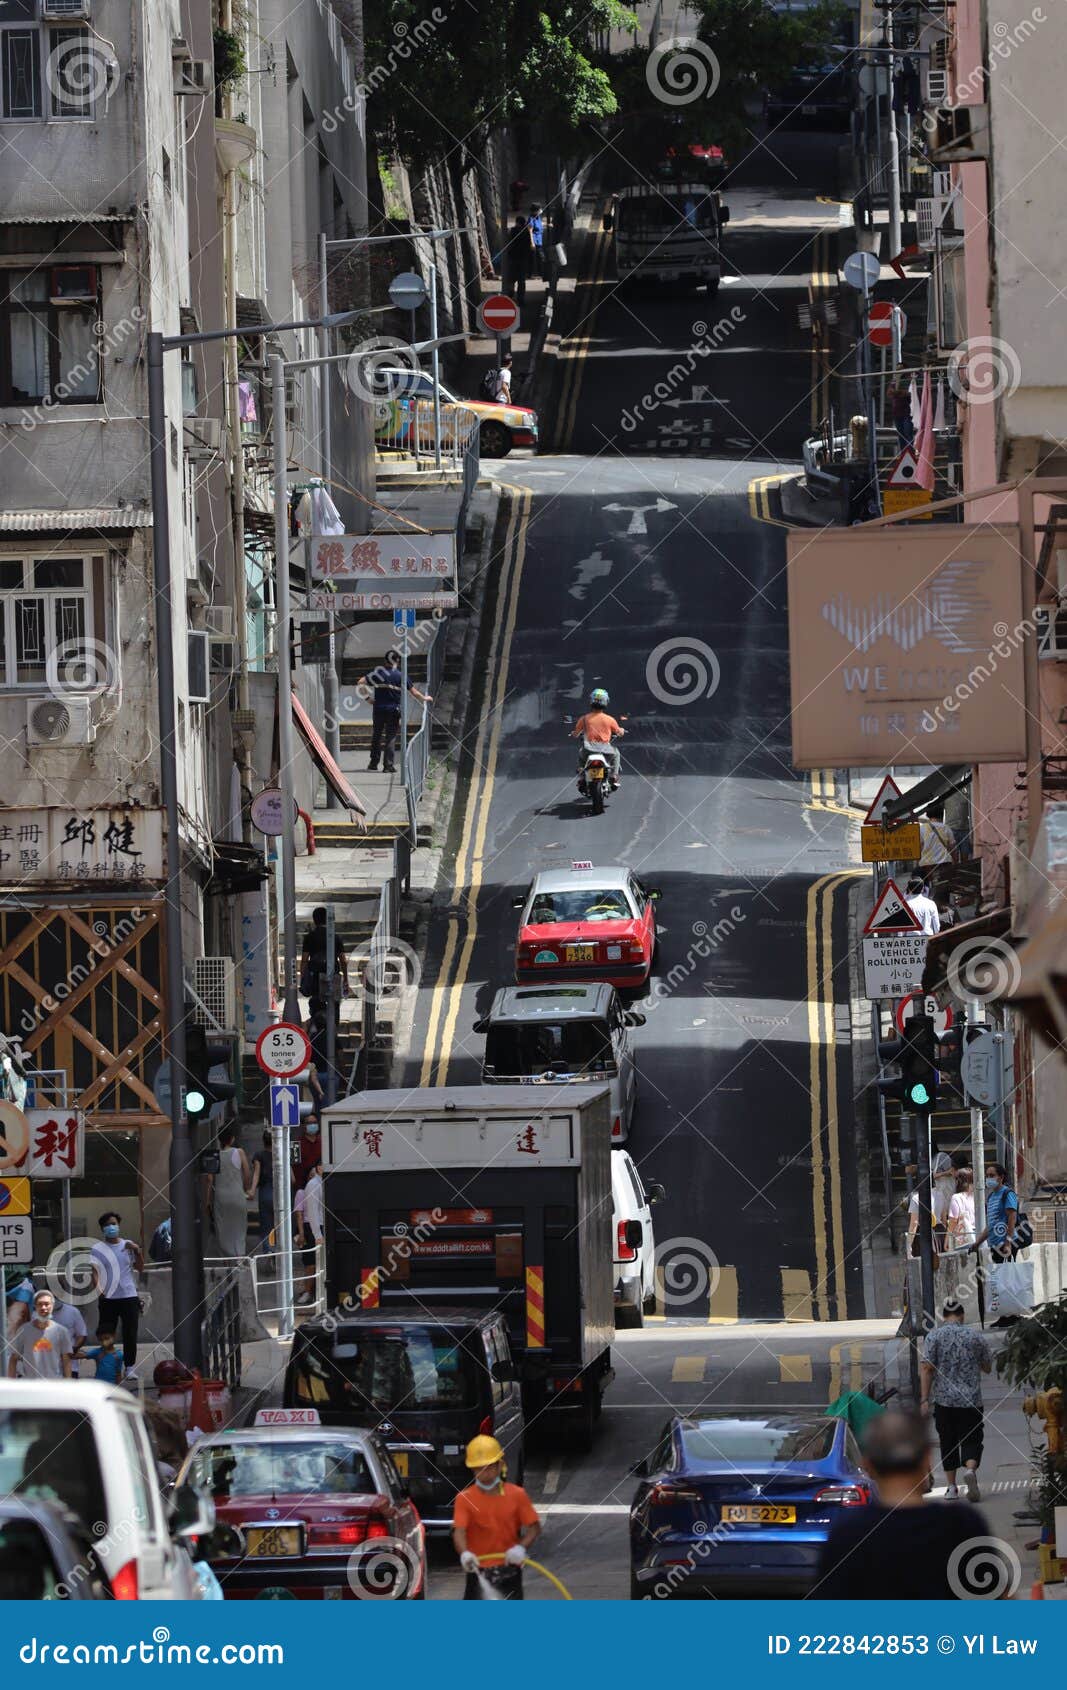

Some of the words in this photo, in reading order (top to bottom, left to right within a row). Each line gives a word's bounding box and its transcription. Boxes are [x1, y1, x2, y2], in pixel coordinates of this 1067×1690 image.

[343, 595, 365, 608] CHI
[843, 665, 889, 692] WE
[60, 816, 142, 857] 邱健
[572, 861, 592, 870] TAXI
[873, 940, 910, 949] BEWARE
[914, 938, 926, 947] OF
[880, 948, 920, 957] VEHICLE
[867, 957, 908, 967] ROLLING
[910, 956, 926, 965] BAC
[890, 968, 912, 980] 小心
[880, 982, 914, 994] 車輛溜
[272, 1034, 294, 1047] 5.5
[516, 1125, 540, 1155] 達
[261, 1410, 315, 1423] TAXI
[751, 1508, 790, 1520] 5273
